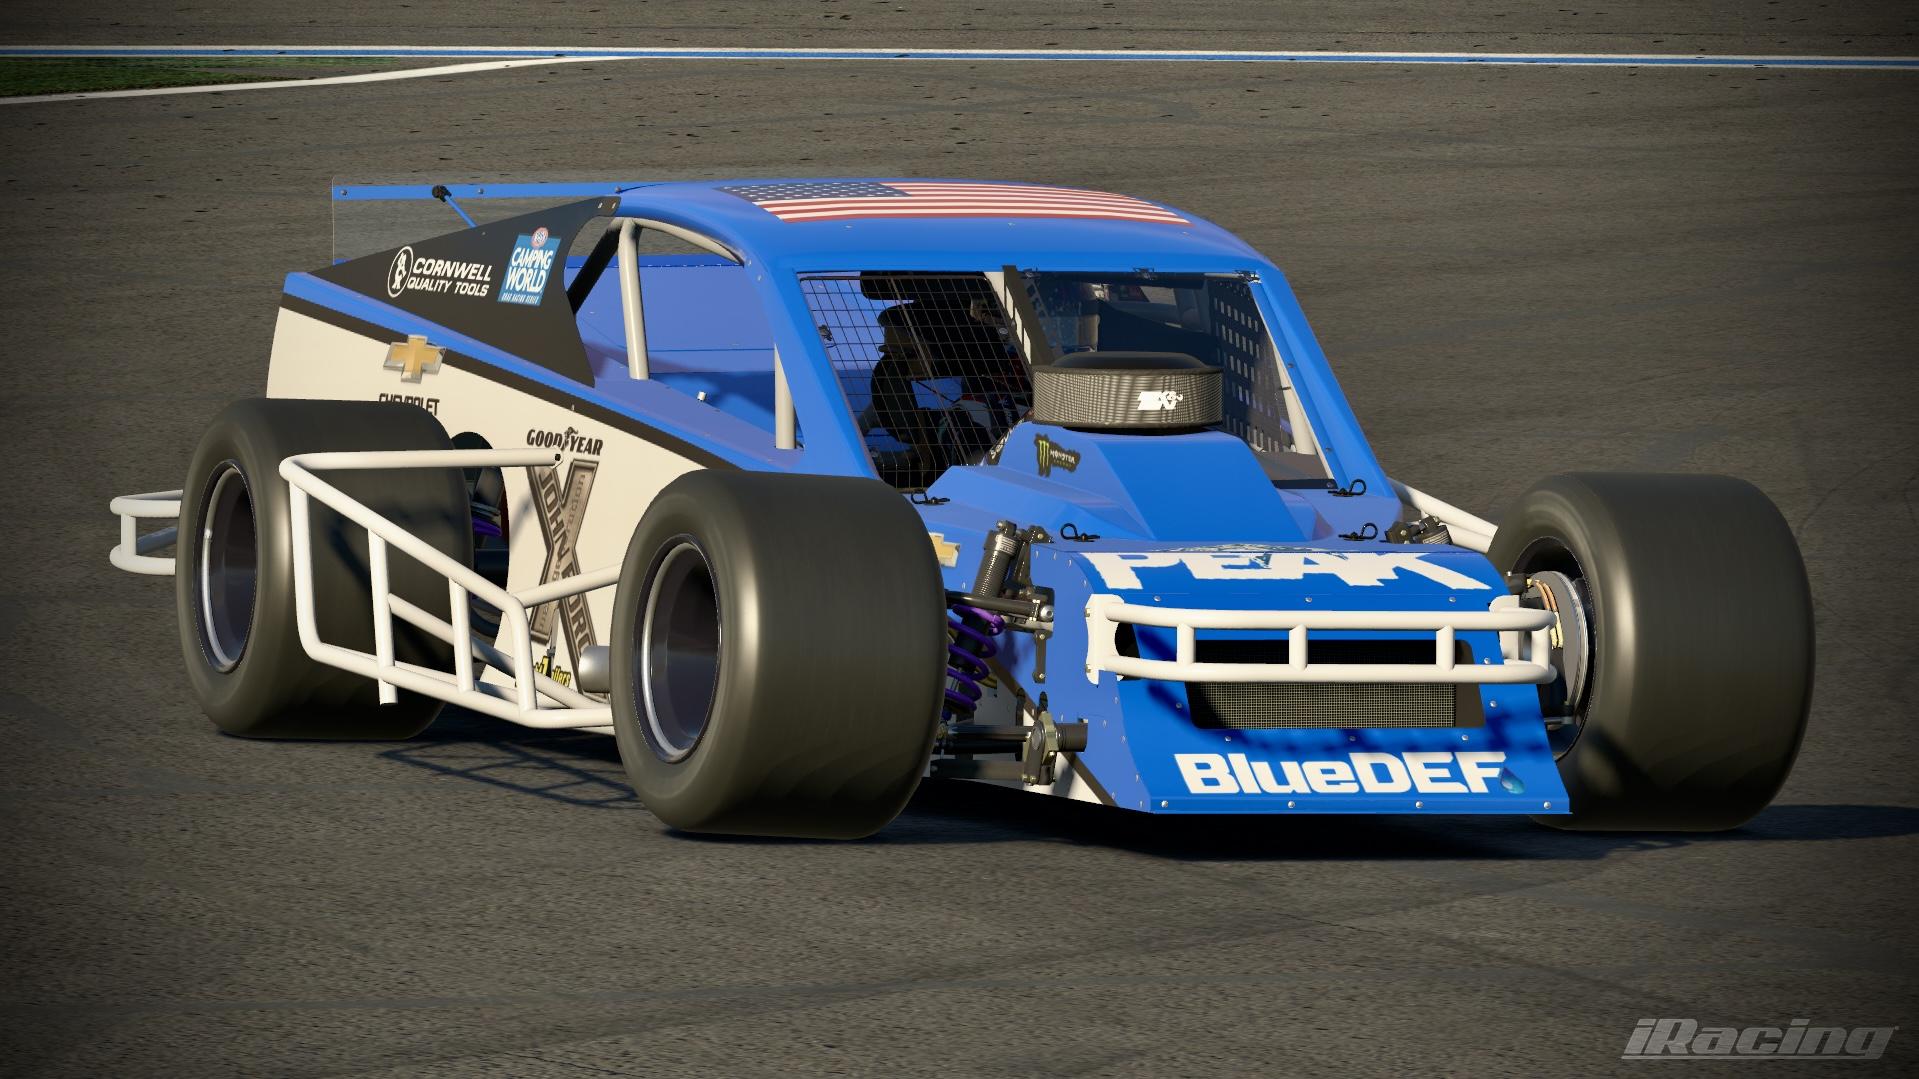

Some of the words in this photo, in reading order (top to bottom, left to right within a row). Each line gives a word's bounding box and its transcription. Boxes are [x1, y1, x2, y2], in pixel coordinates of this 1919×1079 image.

[412, 257, 493, 282] CORNWELL
[511, 247, 554, 270] CAMPING
[407, 276, 452, 293] QUALITY
[454, 282, 490, 297] TOOLS
[505, 266, 547, 293] WORLD
[538, 471, 570, 560] JOHN
[1082, 551, 1492, 590] PEAK
[1174, 751, 1506, 794] BlueDEF
